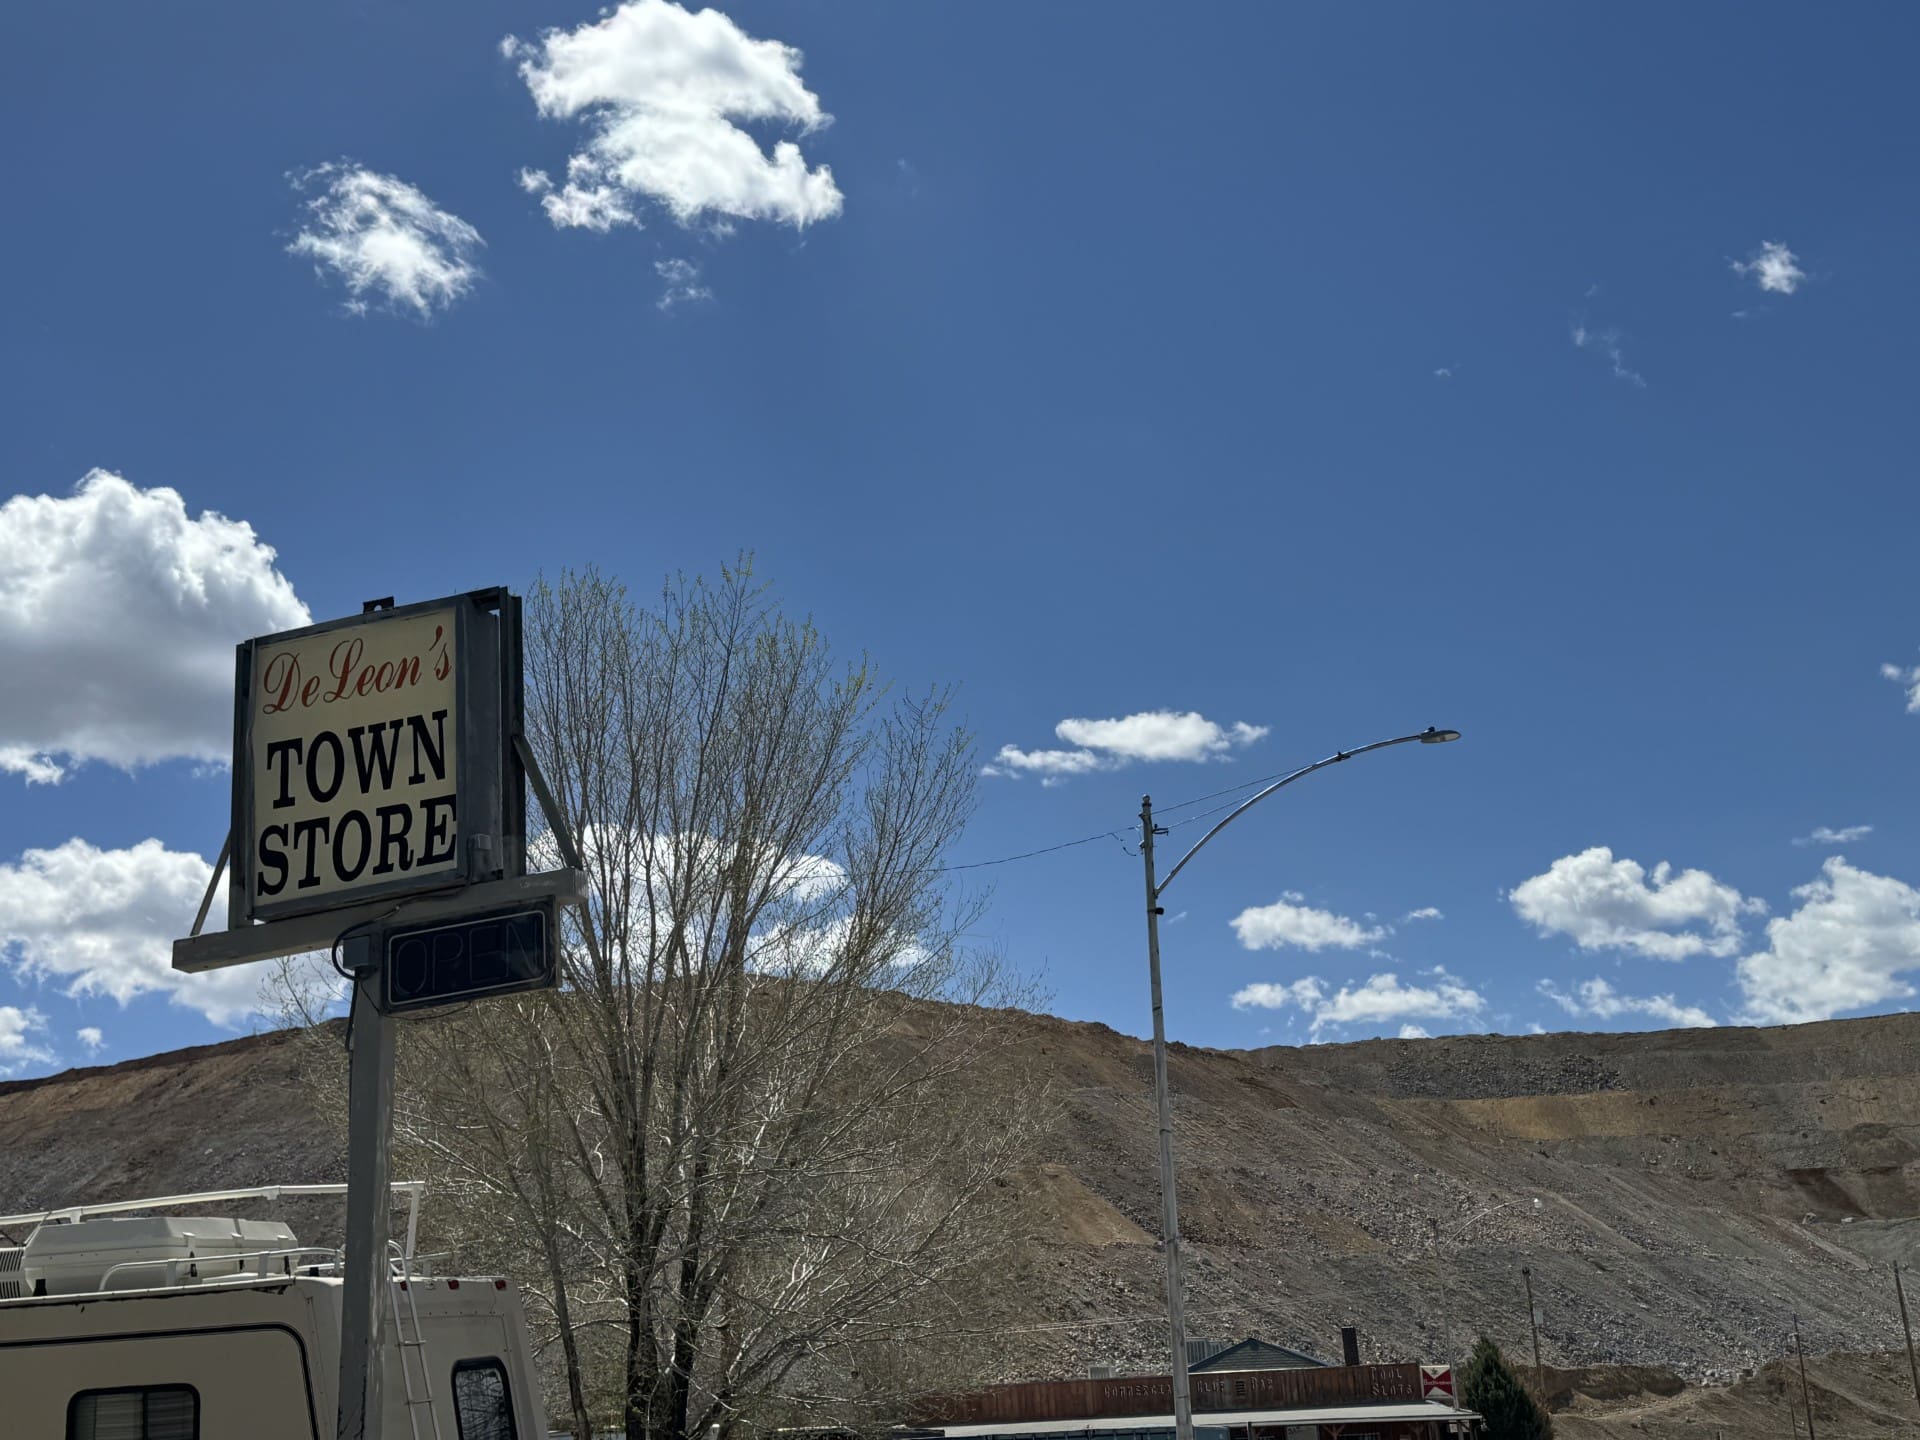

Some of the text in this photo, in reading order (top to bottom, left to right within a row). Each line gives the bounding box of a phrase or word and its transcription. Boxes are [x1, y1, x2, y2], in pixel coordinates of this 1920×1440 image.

[266, 709, 448, 809] TOWN
[257, 794, 457, 896] STORE
[395, 914, 538, 995] OPEN
[1103, 1383, 1173, 1399] COMMERCIA
